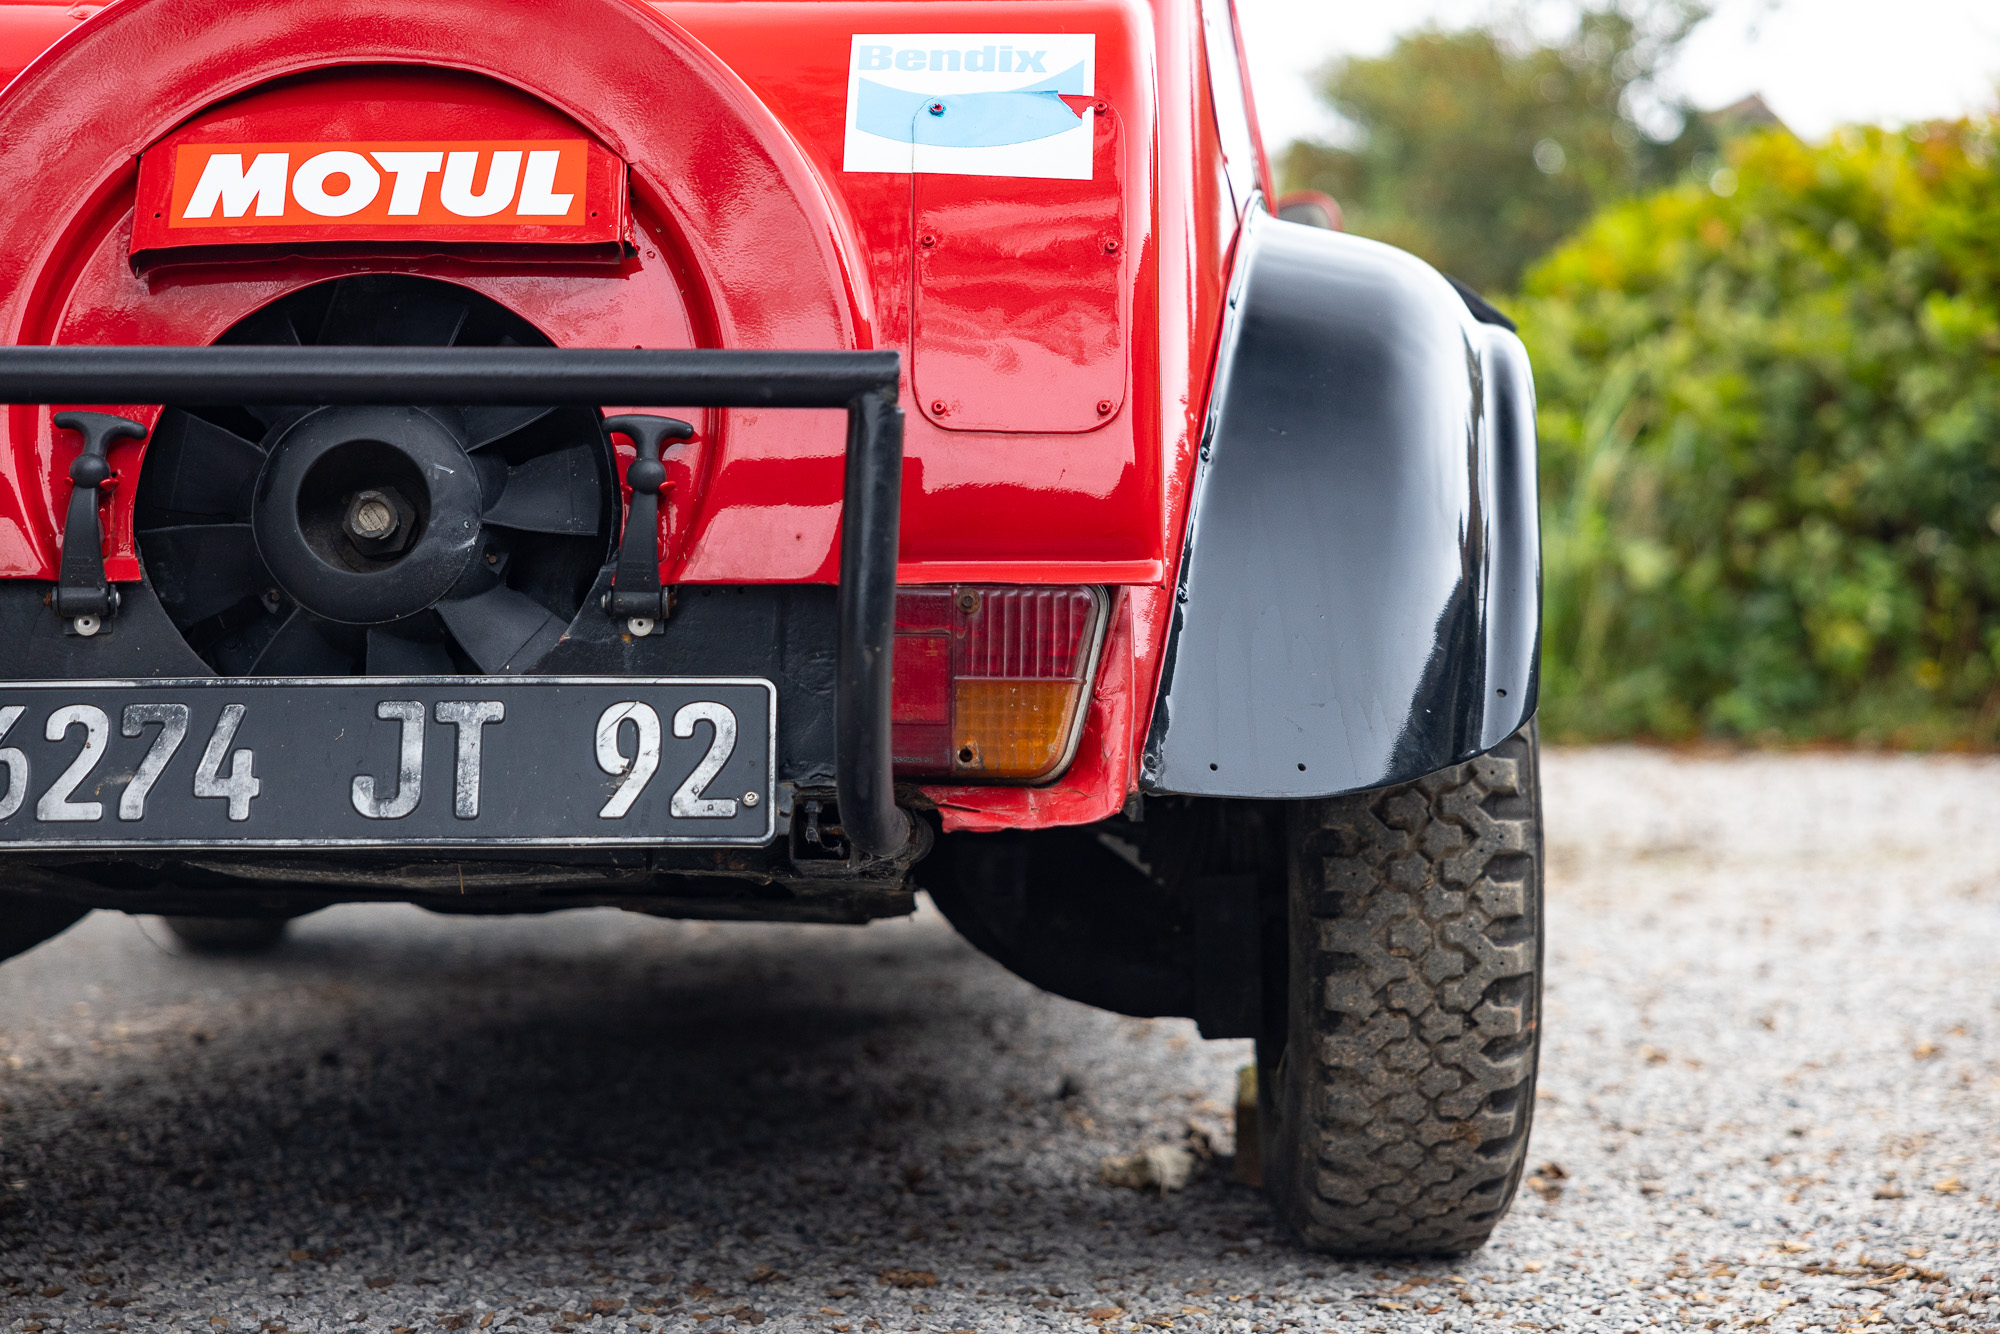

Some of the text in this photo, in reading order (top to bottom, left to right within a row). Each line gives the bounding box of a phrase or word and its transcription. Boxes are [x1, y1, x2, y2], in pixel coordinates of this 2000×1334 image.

[857, 45, 1047, 73] Bendix
[183, 151, 574, 219] MOTUL
[353, 701, 505, 820] JT
[597, 701, 738, 819] 92
